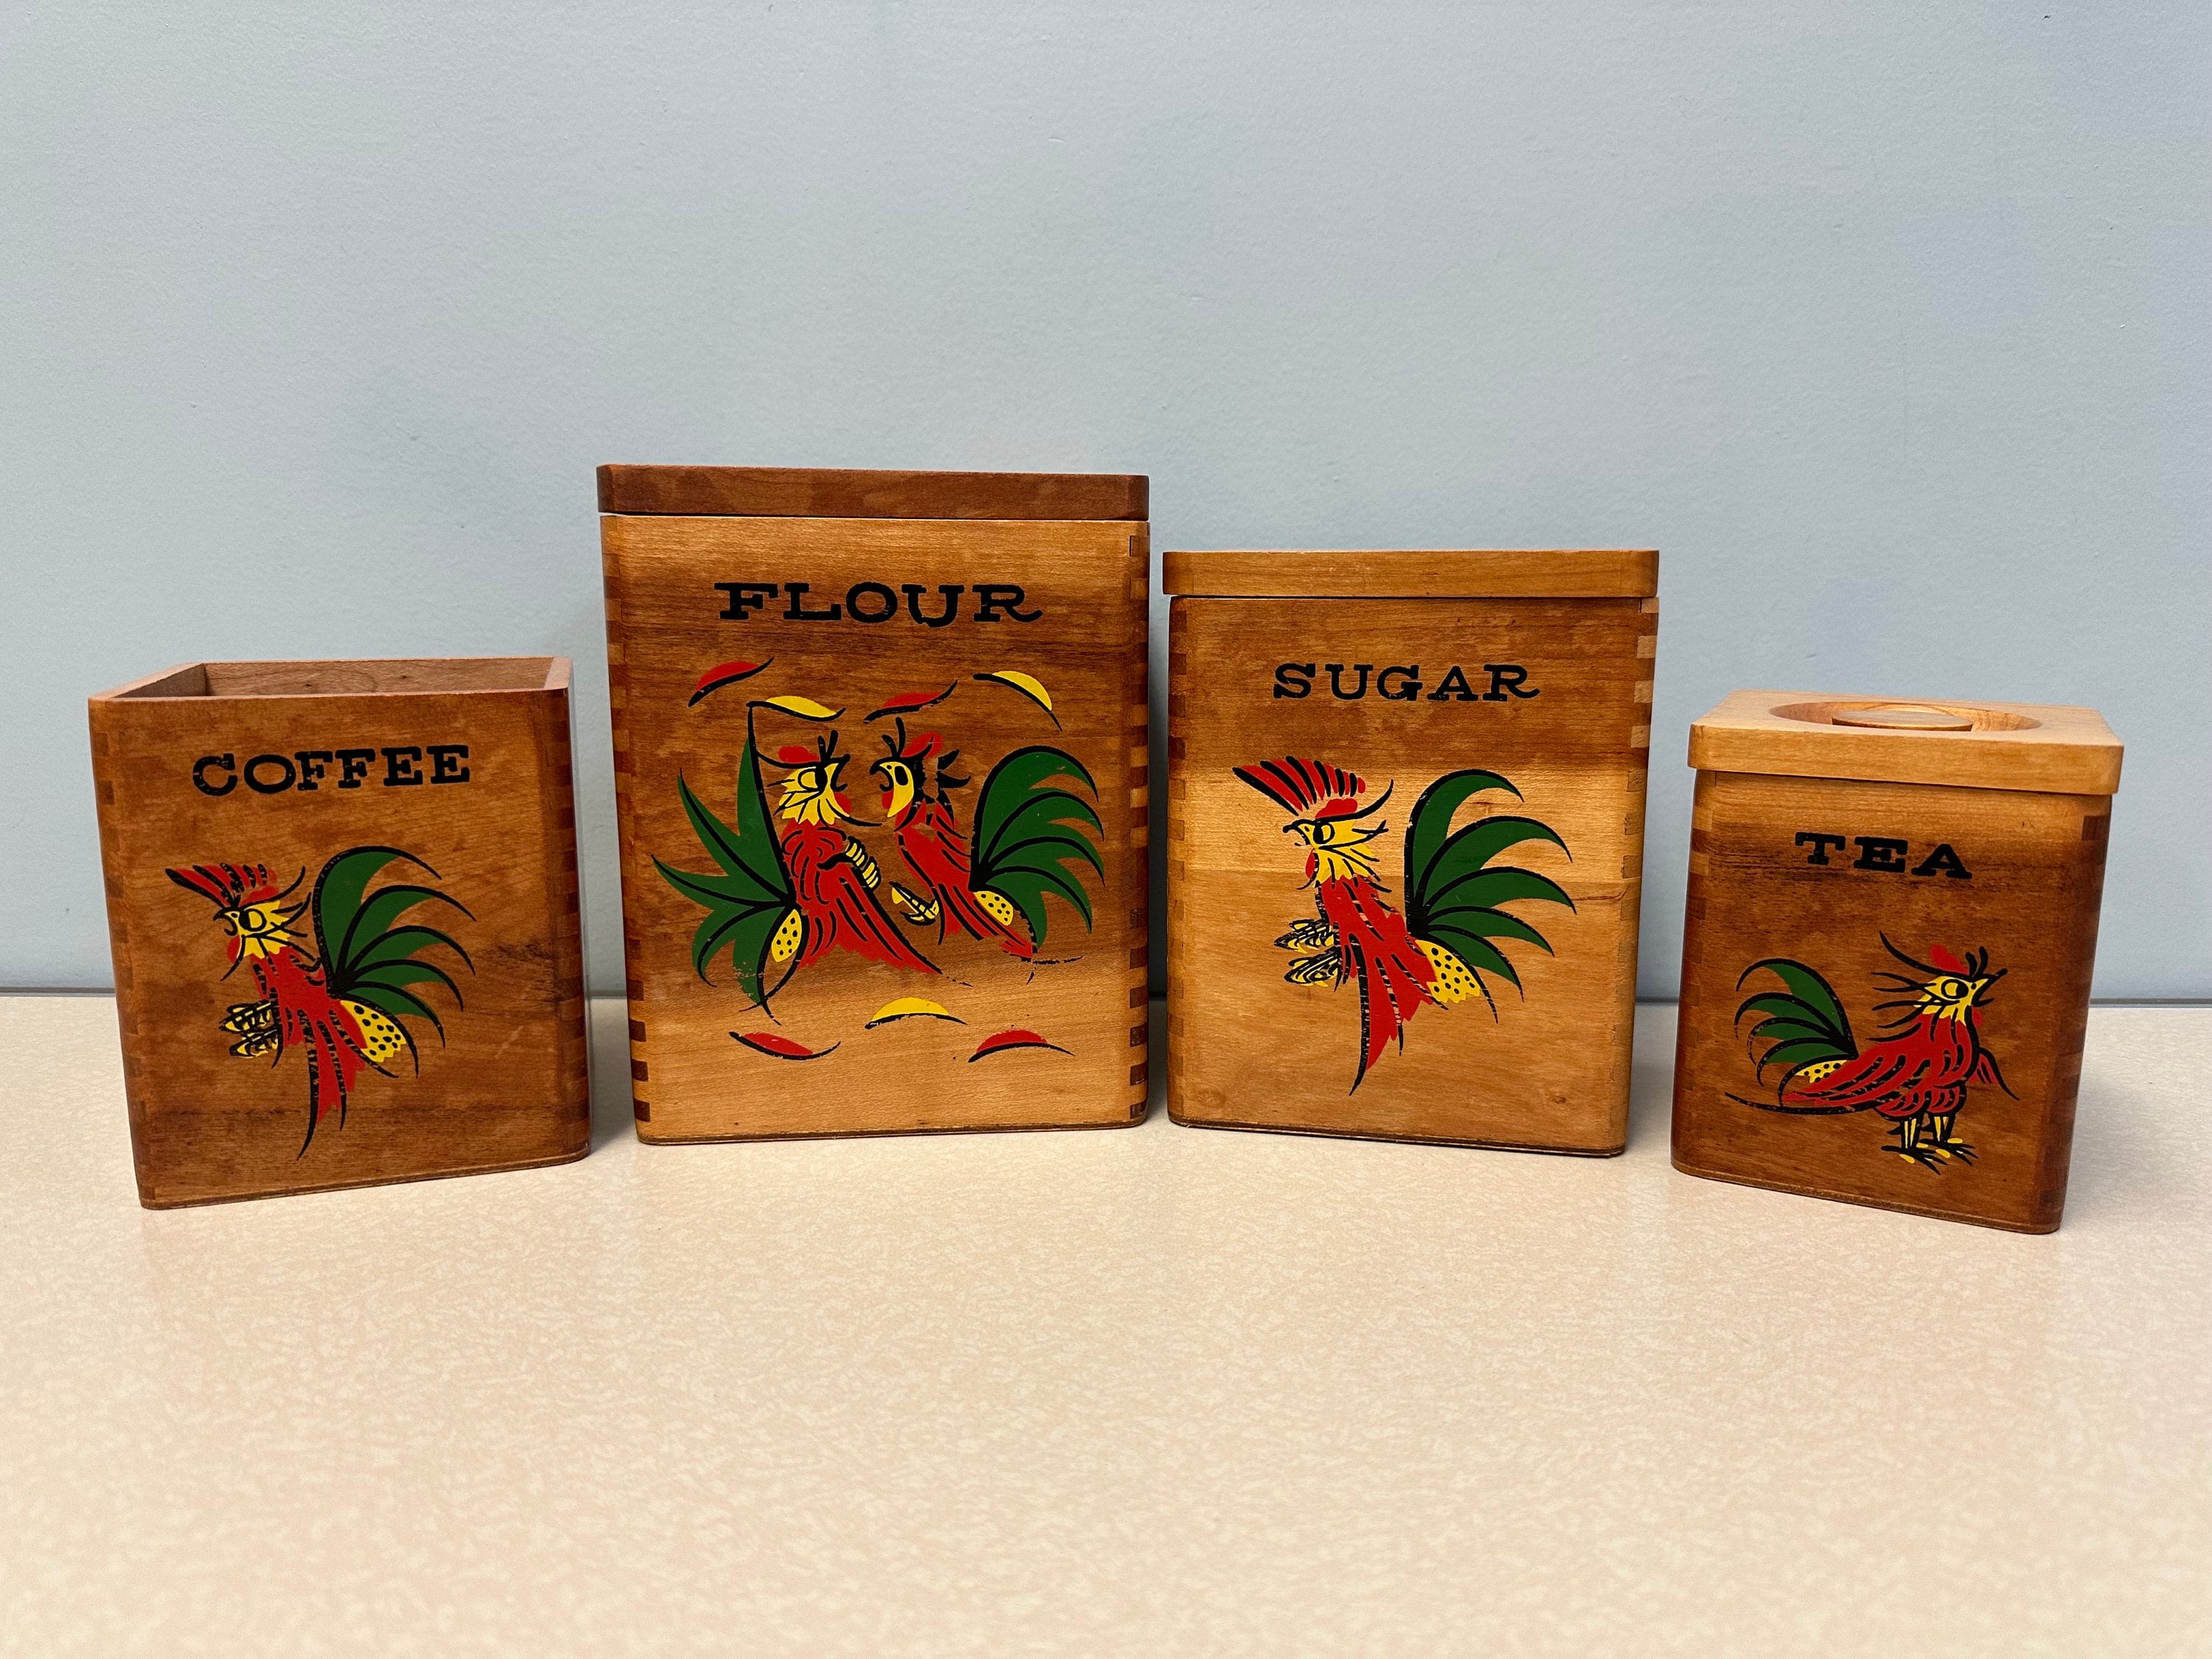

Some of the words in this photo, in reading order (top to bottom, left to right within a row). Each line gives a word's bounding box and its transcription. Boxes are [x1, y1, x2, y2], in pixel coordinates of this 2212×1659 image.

[714, 581, 1043, 628] FLOUR
[1273, 663, 1541, 702] SUGAR
[192, 744, 471, 797] COFFEE
[1795, 831, 1973, 880] TEA
